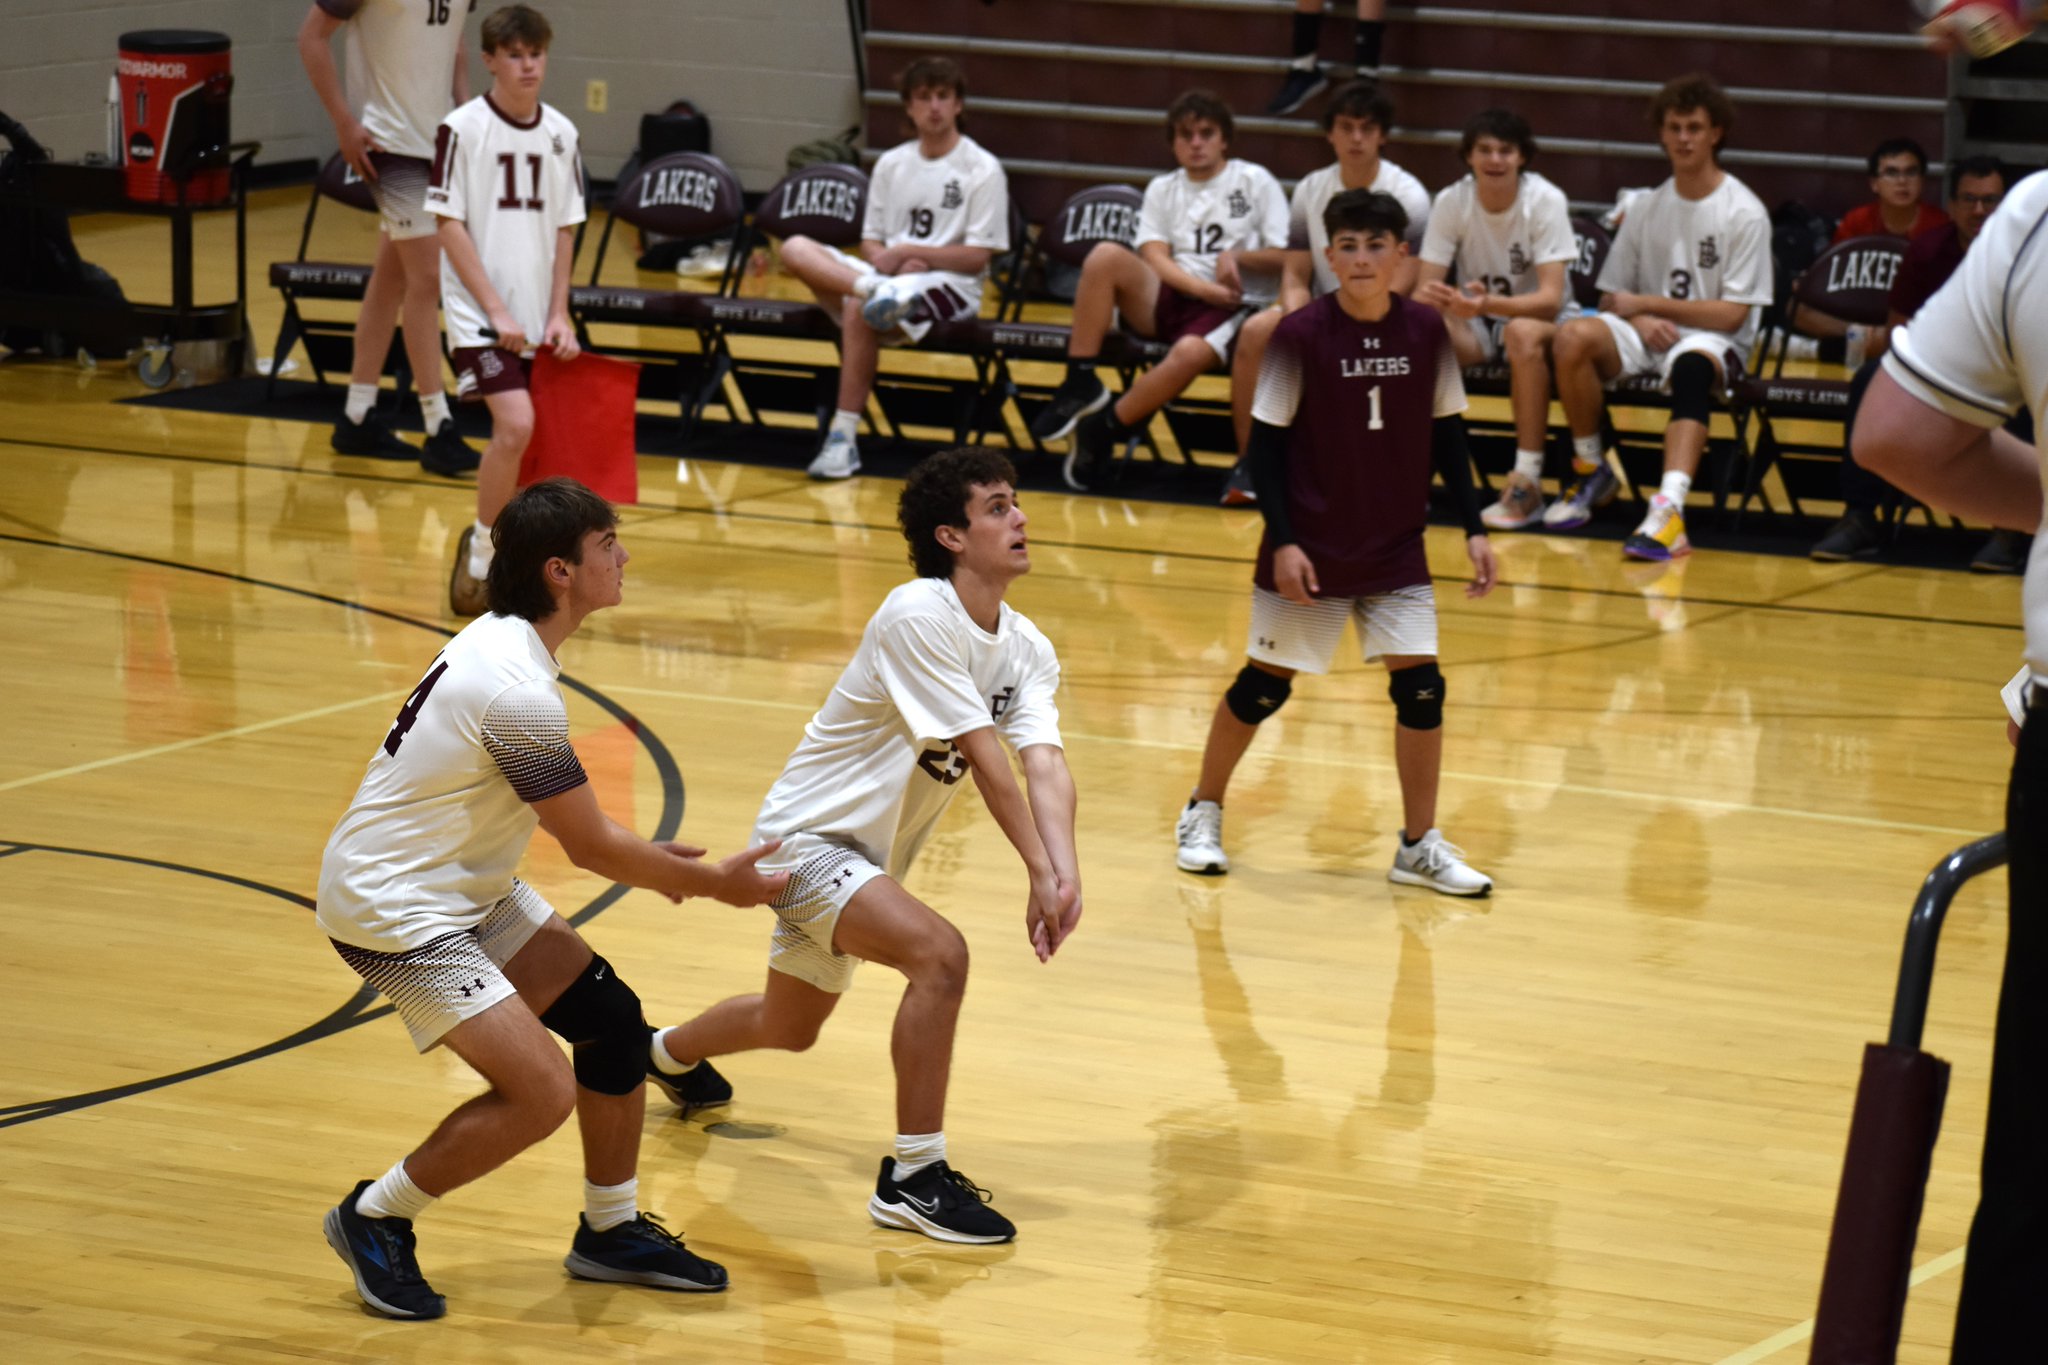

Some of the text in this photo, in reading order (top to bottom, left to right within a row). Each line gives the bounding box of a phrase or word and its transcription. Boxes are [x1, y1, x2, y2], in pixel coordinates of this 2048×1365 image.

[427, 0, 450, 25] 16
[497, 153, 544, 212] 11
[638, 169, 719, 213] LAKERS
[779, 179, 860, 223] LAKERS
[908, 208, 934, 240] 19
[1194, 224, 1224, 253] 12
[326, 271, 363, 284] LATIN
[1670, 269, 1692, 298] 3
[608, 294, 645, 310] LATIN
[748, 308, 784, 323] LATIN
[1029, 333, 1065, 348] LATIN
[1340, 356, 1411, 378] LAKERS
[1367, 385, 1384, 430] 1
[1809, 389, 1849, 405] LATIN
[384, 649, 449, 758] 4
